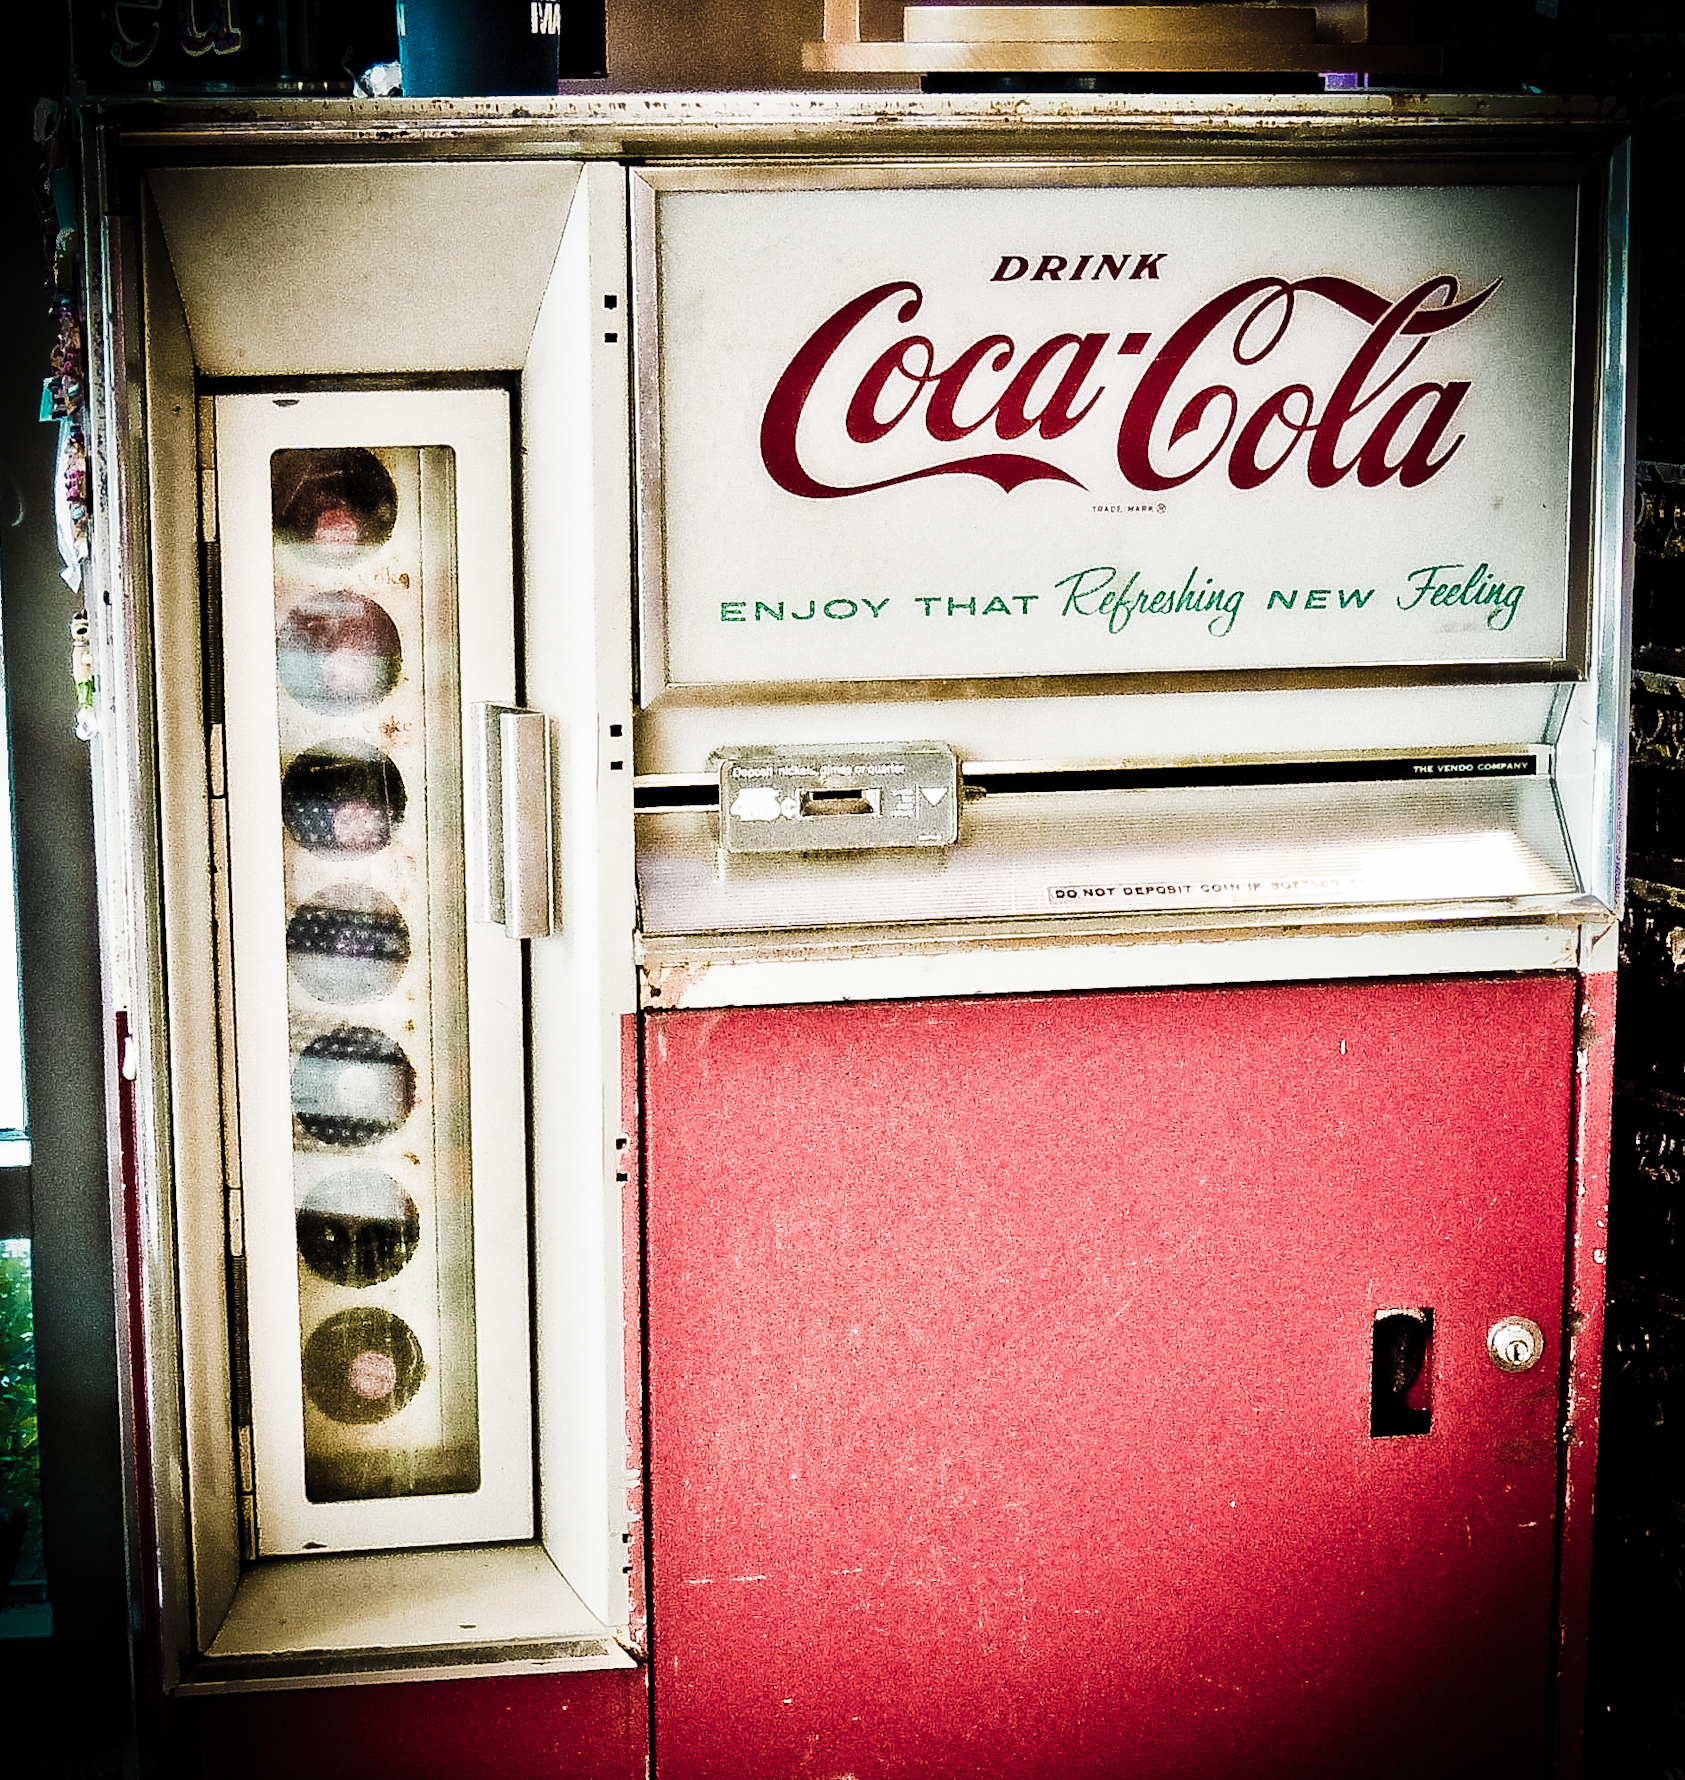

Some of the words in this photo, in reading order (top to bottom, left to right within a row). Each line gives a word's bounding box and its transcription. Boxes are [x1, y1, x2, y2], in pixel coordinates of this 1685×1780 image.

[989, 253, 1168, 282] DRINK
[759, 274, 1503, 499] Coca-Cola
[1091, 505, 1122, 514] TRADE
[1127, 505, 1154, 514] MARK
[720, 599, 888, 622] ENJOY
[915, 595, 1039, 616] THAT
[1053, 566, 1245, 636] Refreshing
[1267, 589, 1375, 610] NEW
[1396, 563, 1524, 631] Feeling
[1412, 764, 1434, 774] THE
[1437, 763, 1474, 773] VENDO
[1476, 761, 1529, 772] COMPANY
[1055, 889, 1078, 899] DO
[1083, 887, 1116, 897] NOT
[1123, 884, 1192, 896] DEPOSIT
